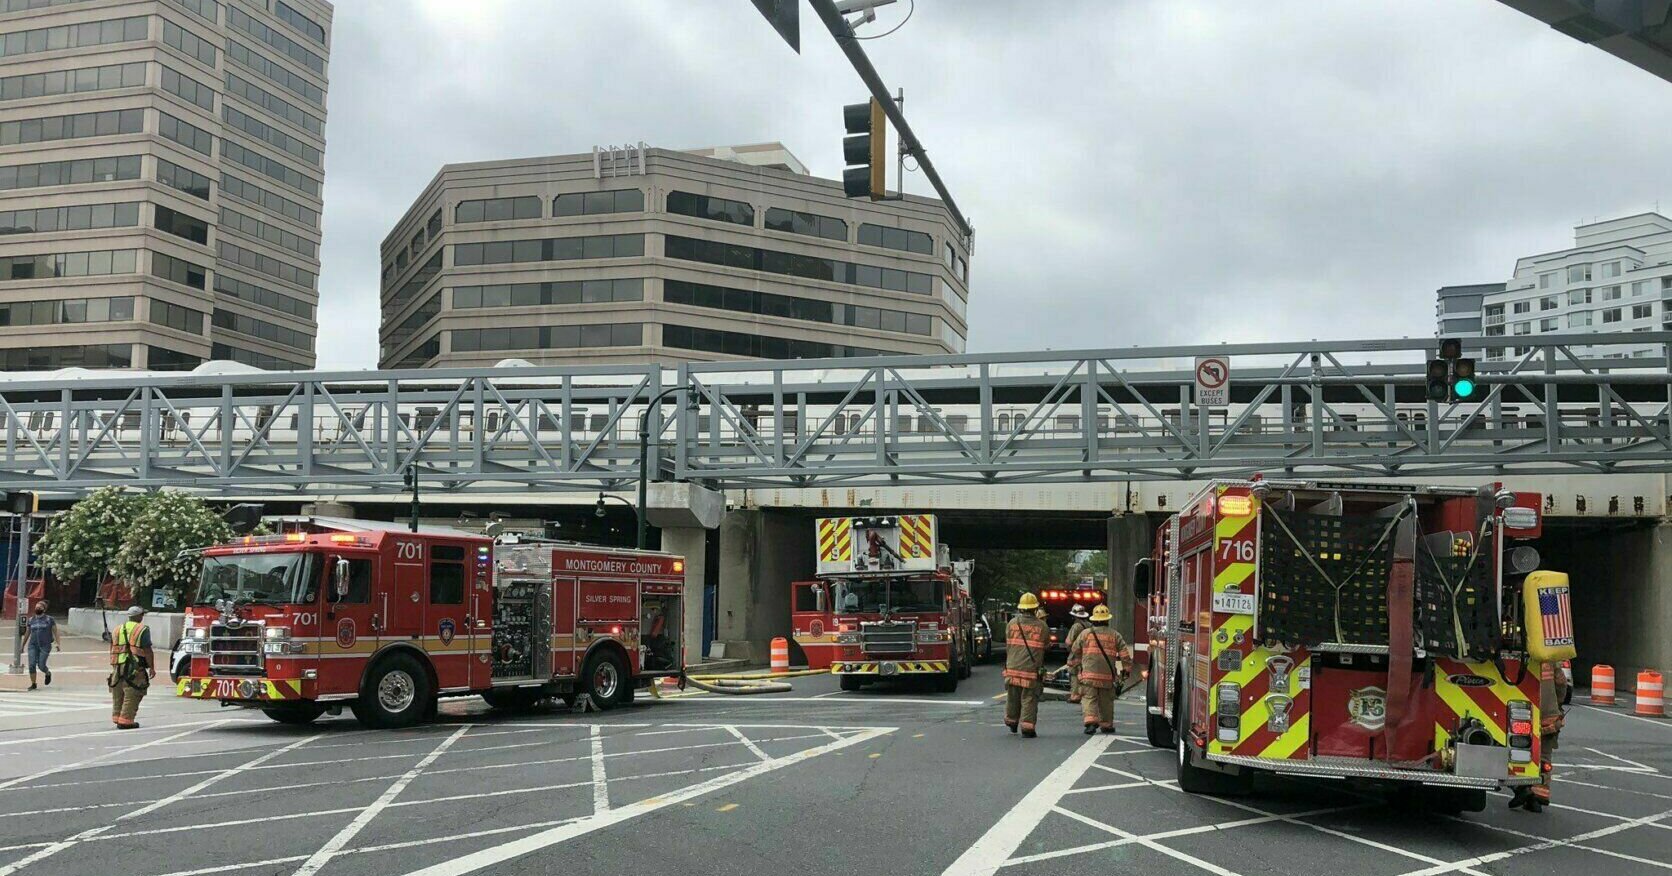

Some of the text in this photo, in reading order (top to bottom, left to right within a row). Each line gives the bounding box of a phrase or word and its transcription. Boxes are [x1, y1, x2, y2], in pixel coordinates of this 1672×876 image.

[396, 542, 422, 559] 701
[1221, 540, 1254, 561] 716
[565, 559, 661, 573] MONTGOMERY COUNTY
[1540, 587, 1569, 595] KEEP
[585, 594, 632, 604] SILVER SPRING
[292, 612, 317, 626] 701
[1545, 638, 1574, 646] BACK
[216, 679, 235, 697] 701
